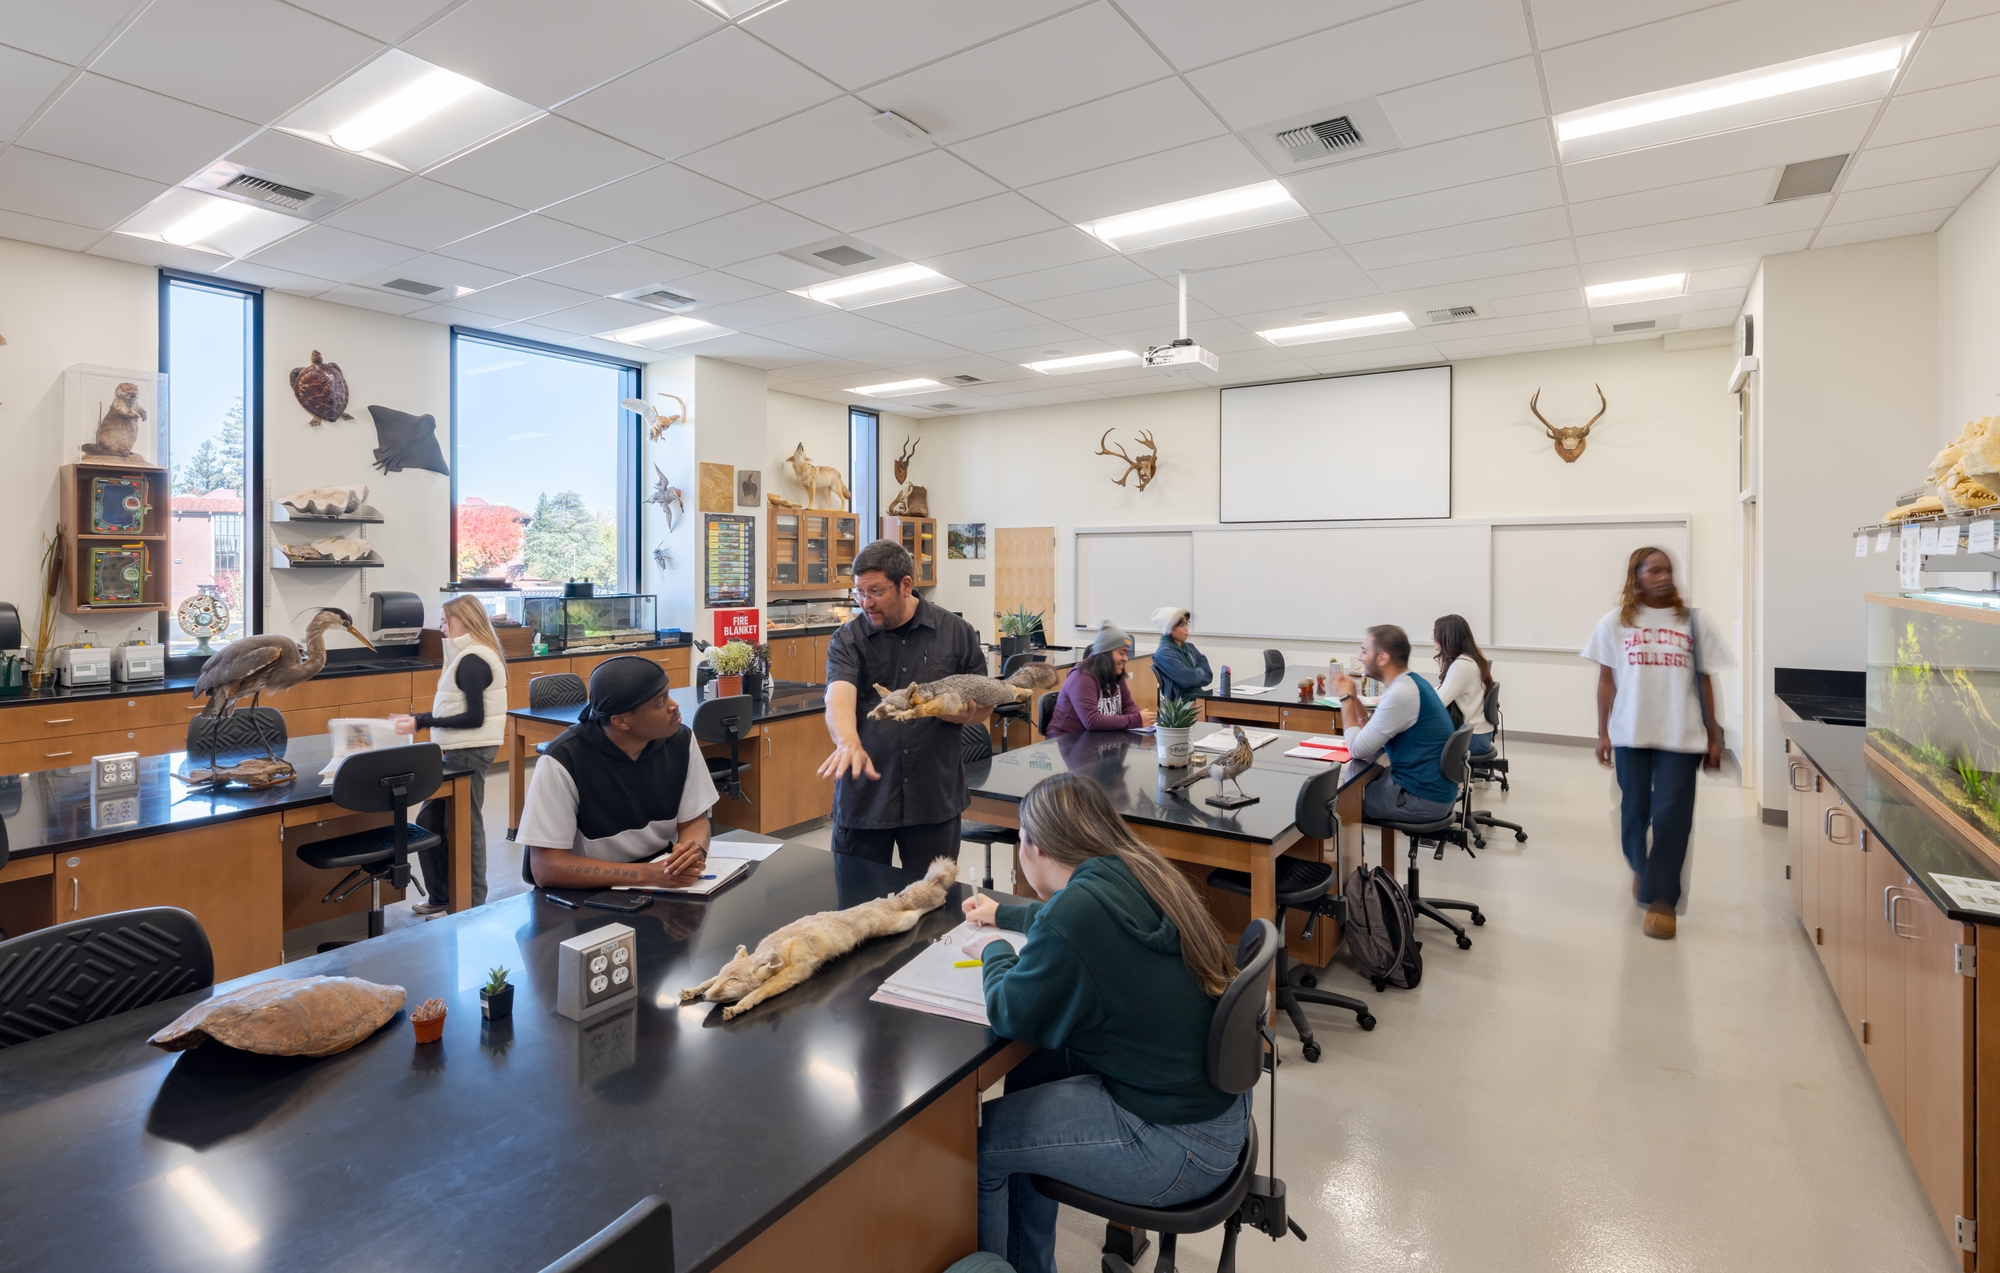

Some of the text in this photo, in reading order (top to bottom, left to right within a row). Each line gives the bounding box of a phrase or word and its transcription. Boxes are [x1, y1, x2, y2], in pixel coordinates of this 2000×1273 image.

[733, 616, 748, 626] FIRE
[724, 625, 757, 636] BLANKET
[1625, 628, 1694, 653] SAC CITY
[1628, 652, 1689, 668] COLLEGE
